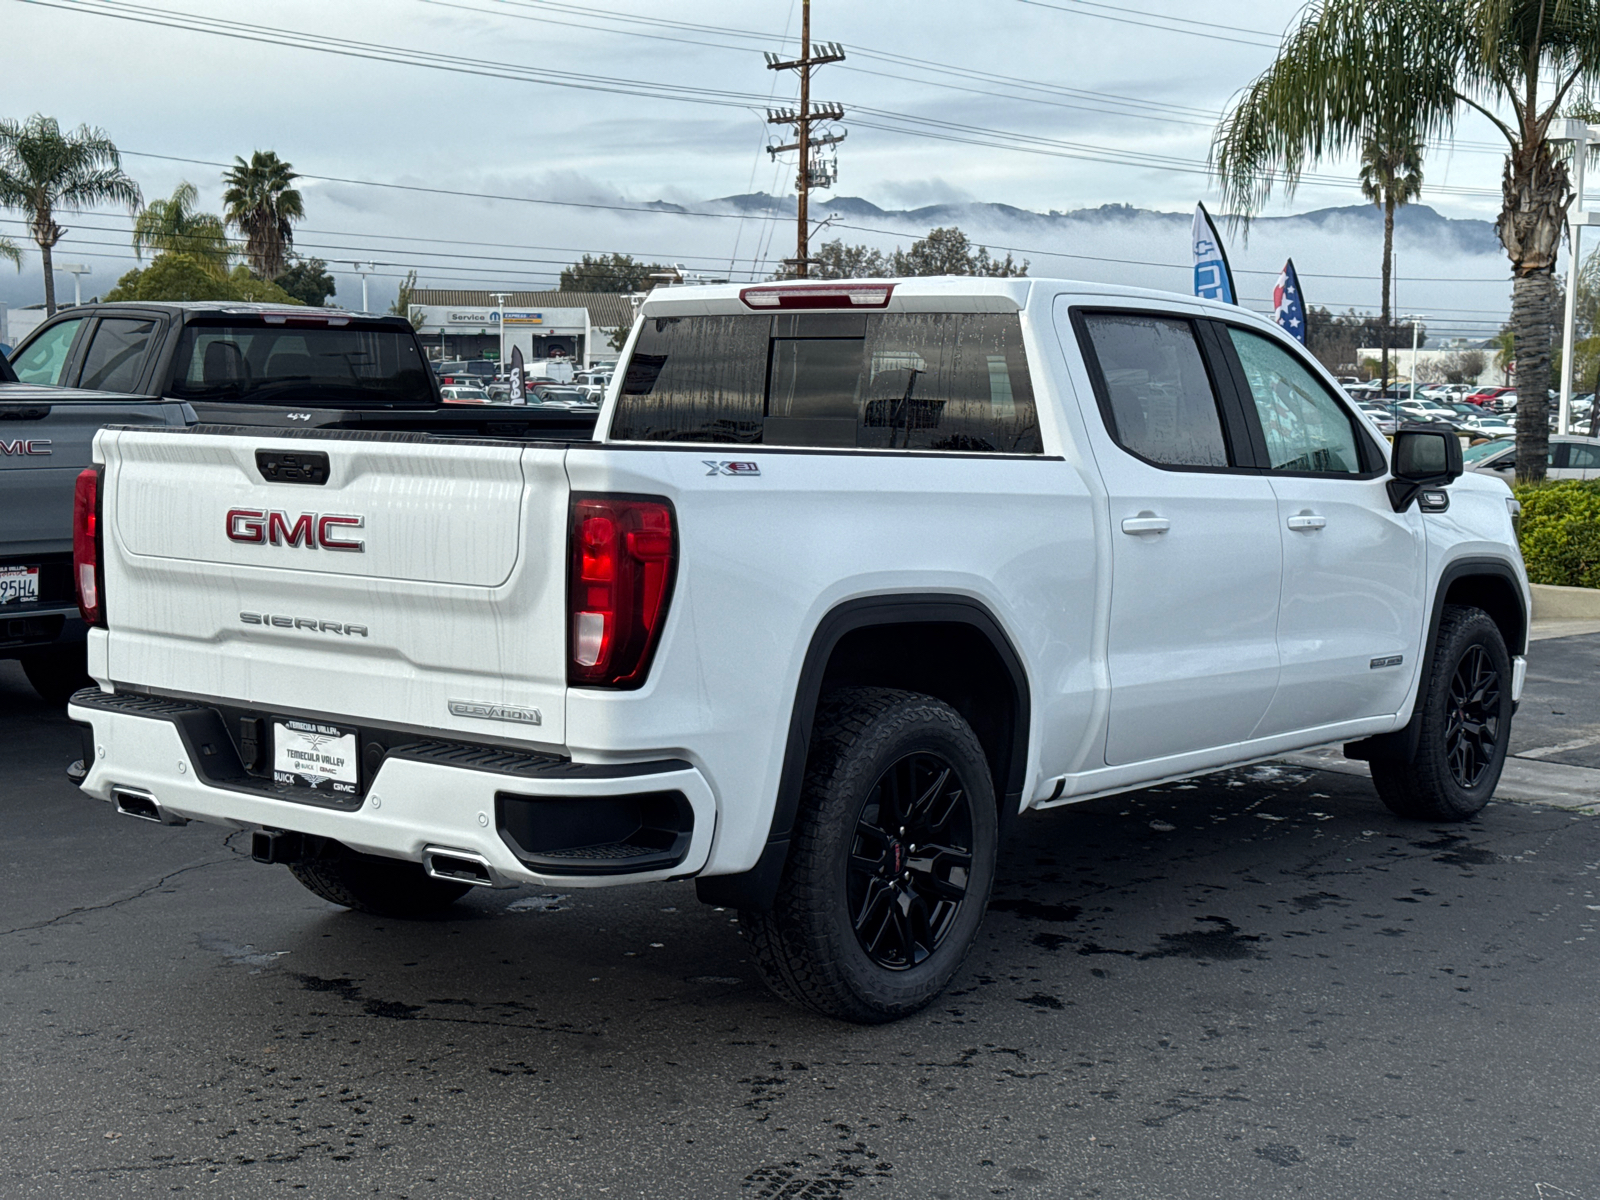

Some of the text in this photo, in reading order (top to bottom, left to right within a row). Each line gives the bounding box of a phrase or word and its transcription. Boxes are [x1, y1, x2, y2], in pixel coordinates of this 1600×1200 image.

[452, 313, 485, 321] Service
[225, 506, 365, 553] GMC
[239, 610, 368, 637] SIERRA
[453, 703, 535, 722] ELEVATION
[288, 721, 338, 736] TEMECULA VALLEY
[286, 749, 345, 768] TEMECULA VALLEY
[273, 771, 295, 784] BUICK
[333, 783, 355, 793] GMC
